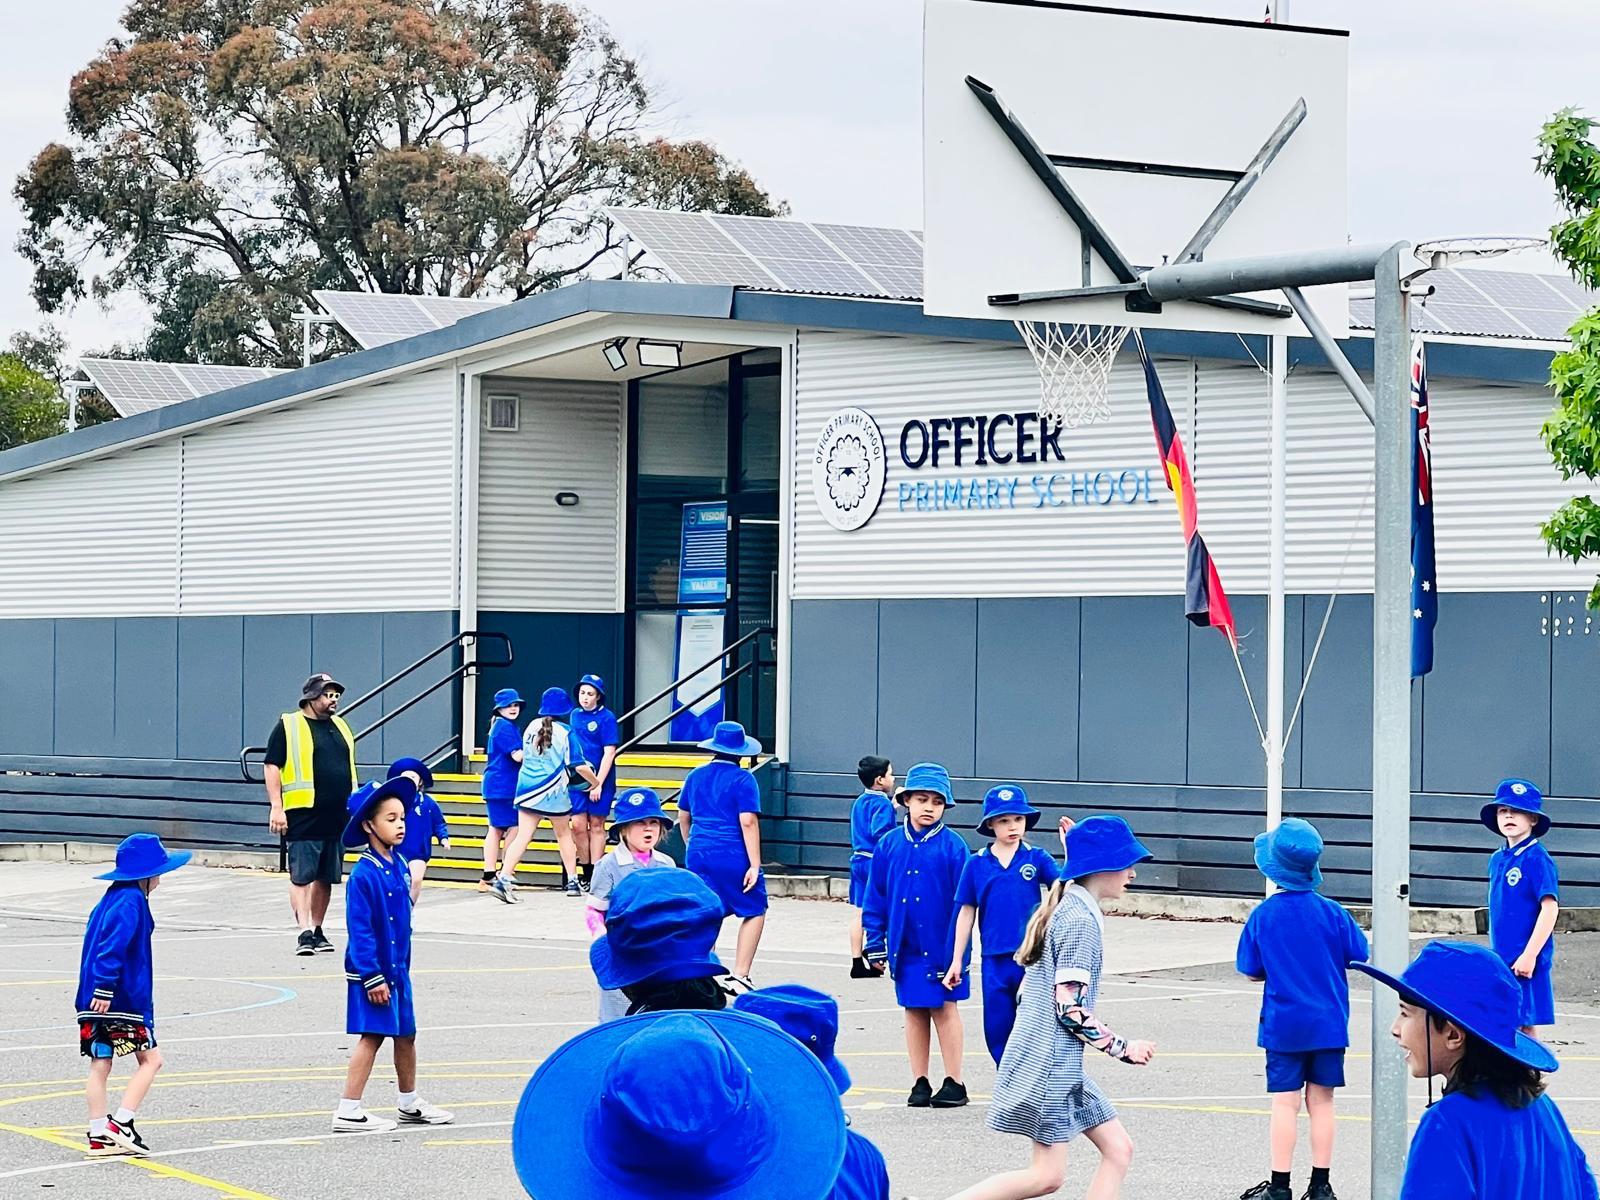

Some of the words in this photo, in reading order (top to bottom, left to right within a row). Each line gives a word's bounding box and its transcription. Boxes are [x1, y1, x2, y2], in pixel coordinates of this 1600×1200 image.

[816, 424, 835, 464] OFFICER
[862, 421, 881, 461] SCHOOL
[900, 412, 1065, 469] OFFICER
[898, 477, 1019, 512] PRIMARY
[1031, 468, 1159, 508] SCHOOL
